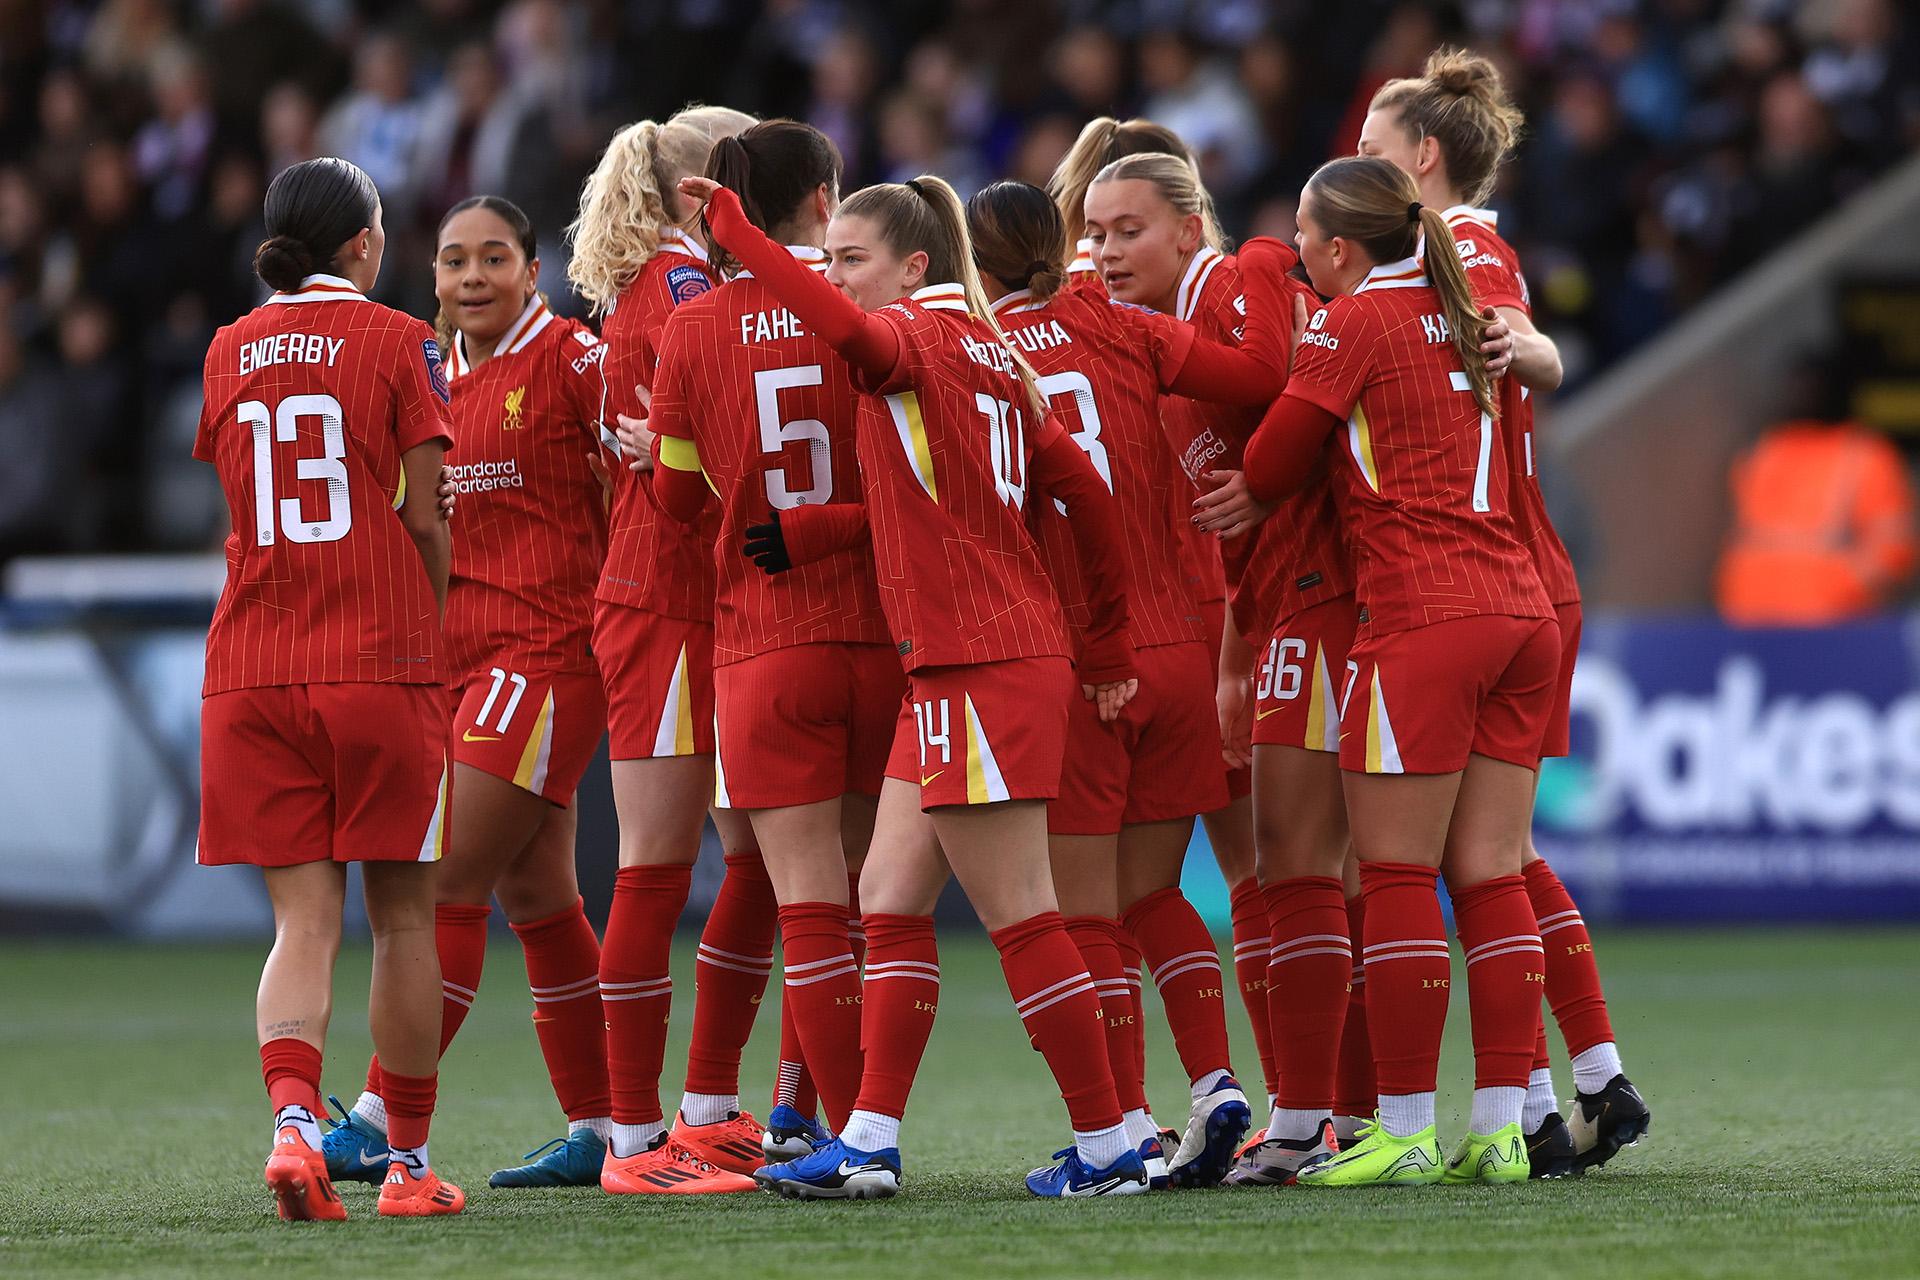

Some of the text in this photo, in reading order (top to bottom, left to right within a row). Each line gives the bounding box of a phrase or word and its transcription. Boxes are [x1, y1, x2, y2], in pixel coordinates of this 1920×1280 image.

[741, 308, 815, 344] FAHE
[239, 333, 345, 376] ENDERBY
[754, 364, 833, 510] 5
[1448, 372, 1492, 513] 7
[236, 394, 352, 547] 13
[1257, 638, 1306, 700] 36
[475, 667, 527, 734] 11
[914, 698, 950, 766] 14
[1567, 943, 1591, 955] LFC
[835, 995, 863, 1006] LFC
[1199, 988, 1221, 999] LFC
[1422, 979, 1448, 989] LFC
[914, 1000, 936, 1015] LFC
[1110, 1015, 1134, 1027] LFC
